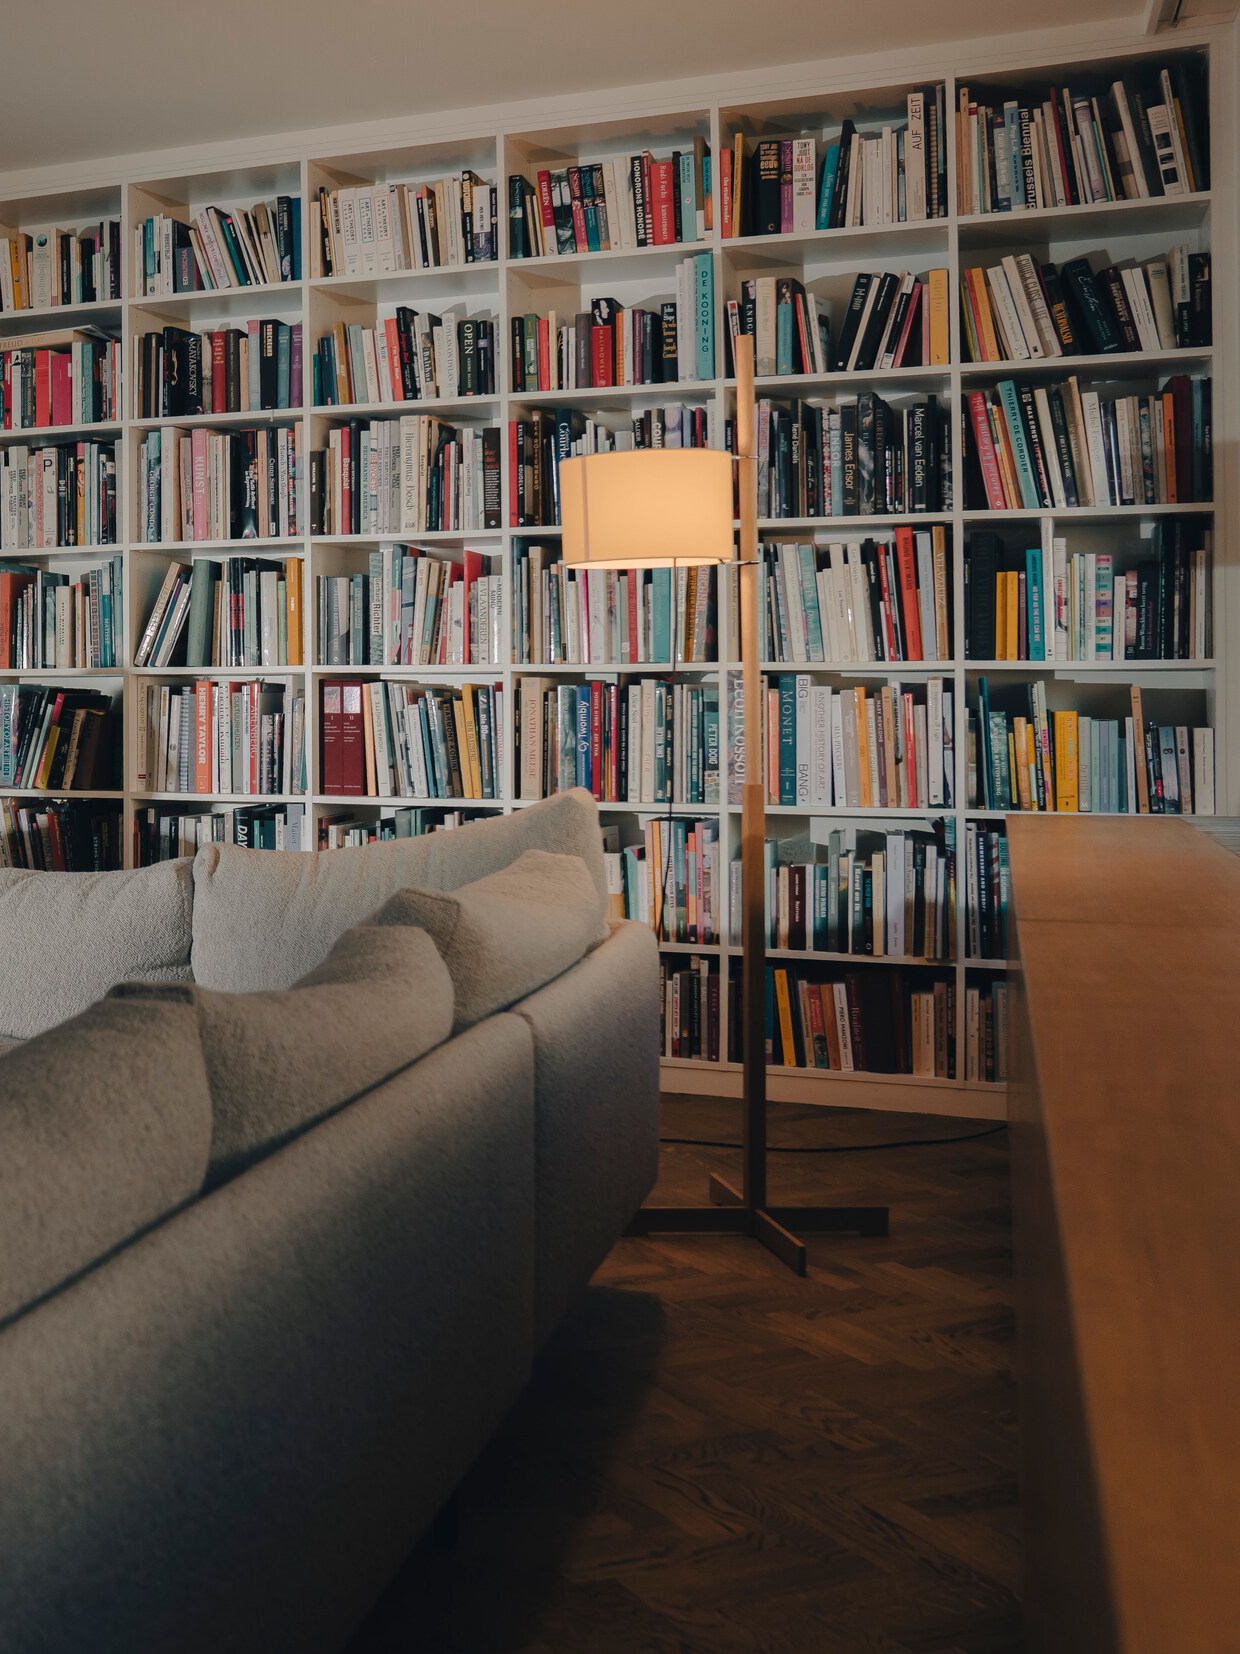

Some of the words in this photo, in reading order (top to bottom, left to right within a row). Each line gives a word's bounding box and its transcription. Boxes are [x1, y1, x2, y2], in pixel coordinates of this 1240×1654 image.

[910, 98, 922, 120] ZEIT
[911, 130, 922, 150] AUF
[997, 131, 1006, 147] Taal
[1019, 108, 1032, 156] Biennial
[998, 148, 1006, 159] en
[572, 172, 580, 197] Sesam
[633, 160, 644, 204] HONORONS
[998, 160, 1007, 184] Teken
[1021, 159, 1037, 210] Brussels
[182, 277, 189, 286] ED
[701, 270, 708, 287] DE
[1016, 258, 1031, 281] CHUCK
[1024, 282, 1039, 303] CLOSE
[1052, 303, 1064, 312] DE
[701, 292, 709, 353] KOONING
[1030, 304, 1046, 321] LIFE
[445, 324, 454, 346] DYLAN
[464, 324, 474, 354] OPEN
[1054, 313, 1073, 345] VERVALSER
[423, 351, 431, 383] Balthus
[446, 347, 454, 358] ON
[188, 340, 197, 396] MAYAKOVSKY
[446, 359, 454, 382] DYLAN
[1006, 387, 1018, 423] THIERRY
[1025, 405, 1035, 420] MAX
[914, 408, 925, 440] Marcel
[1012, 424, 1021, 435] DE
[1029, 421, 1040, 442] ERNST
[559, 422, 570, 459] Courbe
[831, 430, 840, 467] ENSOR
[845, 431, 855, 462] James
[914, 441, 924, 457] van
[1014, 437, 1029, 474] CORDIER
[404, 432, 416, 482] Hieronymus
[978, 423, 991, 451] History
[985, 463, 999, 496] pictures
[194, 456, 204, 495] KUNST
[342, 457, 350, 490] Basquiat
[845, 463, 855, 490] Ensor
[914, 459, 925, 487] Eeden
[405, 484, 416, 512] Bosch
[688, 575, 696, 610] WILHELM
[697, 565, 708, 612] KIRCHNER
[372, 603, 382, 634] Richter
[479, 587, 487, 645] VLAANDEREN
[797, 678, 808, 698] BIG
[528, 698, 537, 747] JONATHAN
[578, 700, 590, 736] Twombly
[782, 690, 792, 745] MONET
[198, 724, 207, 764] TAYLOR
[444, 705, 454, 743] HARMONY
[449, 744, 457, 773] KORINE
[578, 739, 590, 752] Cy
[708, 723, 718, 745] PETER
[529, 749, 537, 779] MEESE
[708, 747, 718, 764] DOIG
[818, 762, 825, 772] OF
[797, 763, 809, 797] BANG
[237, 825, 248, 848] DAY
